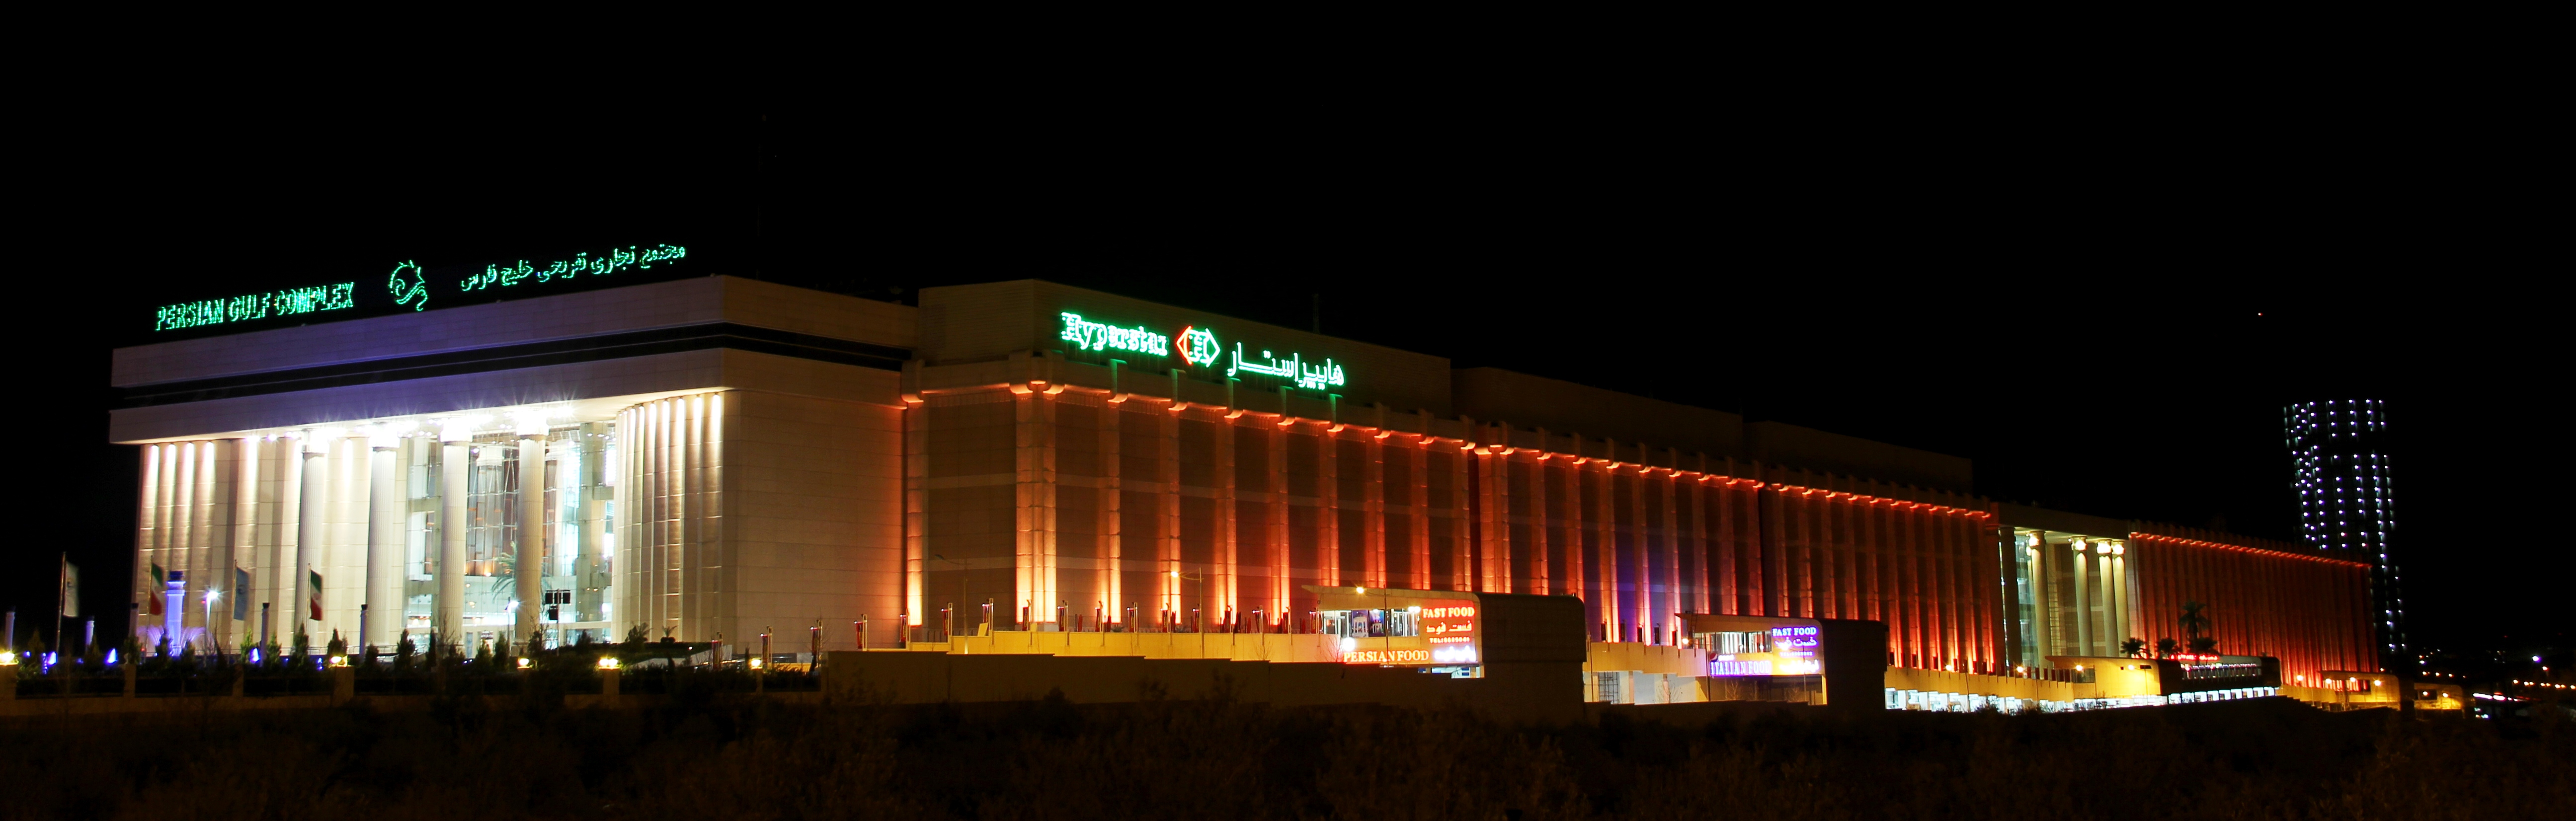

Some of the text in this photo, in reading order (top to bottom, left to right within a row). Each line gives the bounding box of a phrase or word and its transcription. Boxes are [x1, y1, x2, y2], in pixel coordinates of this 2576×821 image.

[461, 244, 685, 292] مجتمع تجاری تفریحی خلیج فارس
[155, 282, 354, 331] PERSIAN GULF COMPLEX
[1061, 312, 1169, 357] Hyperstar
[1423, 607, 1475, 618] FAST FOOD
[1426, 620, 1472, 635] فست فود
[1772, 627, 1817, 636] FAST FOOD
[1343, 651, 1396, 662] PERSIAN
[1397, 650, 1430, 661] FOOD
[1710, 661, 1746, 675] ITALIAN
[1748, 660, 1771, 674] FOOD
